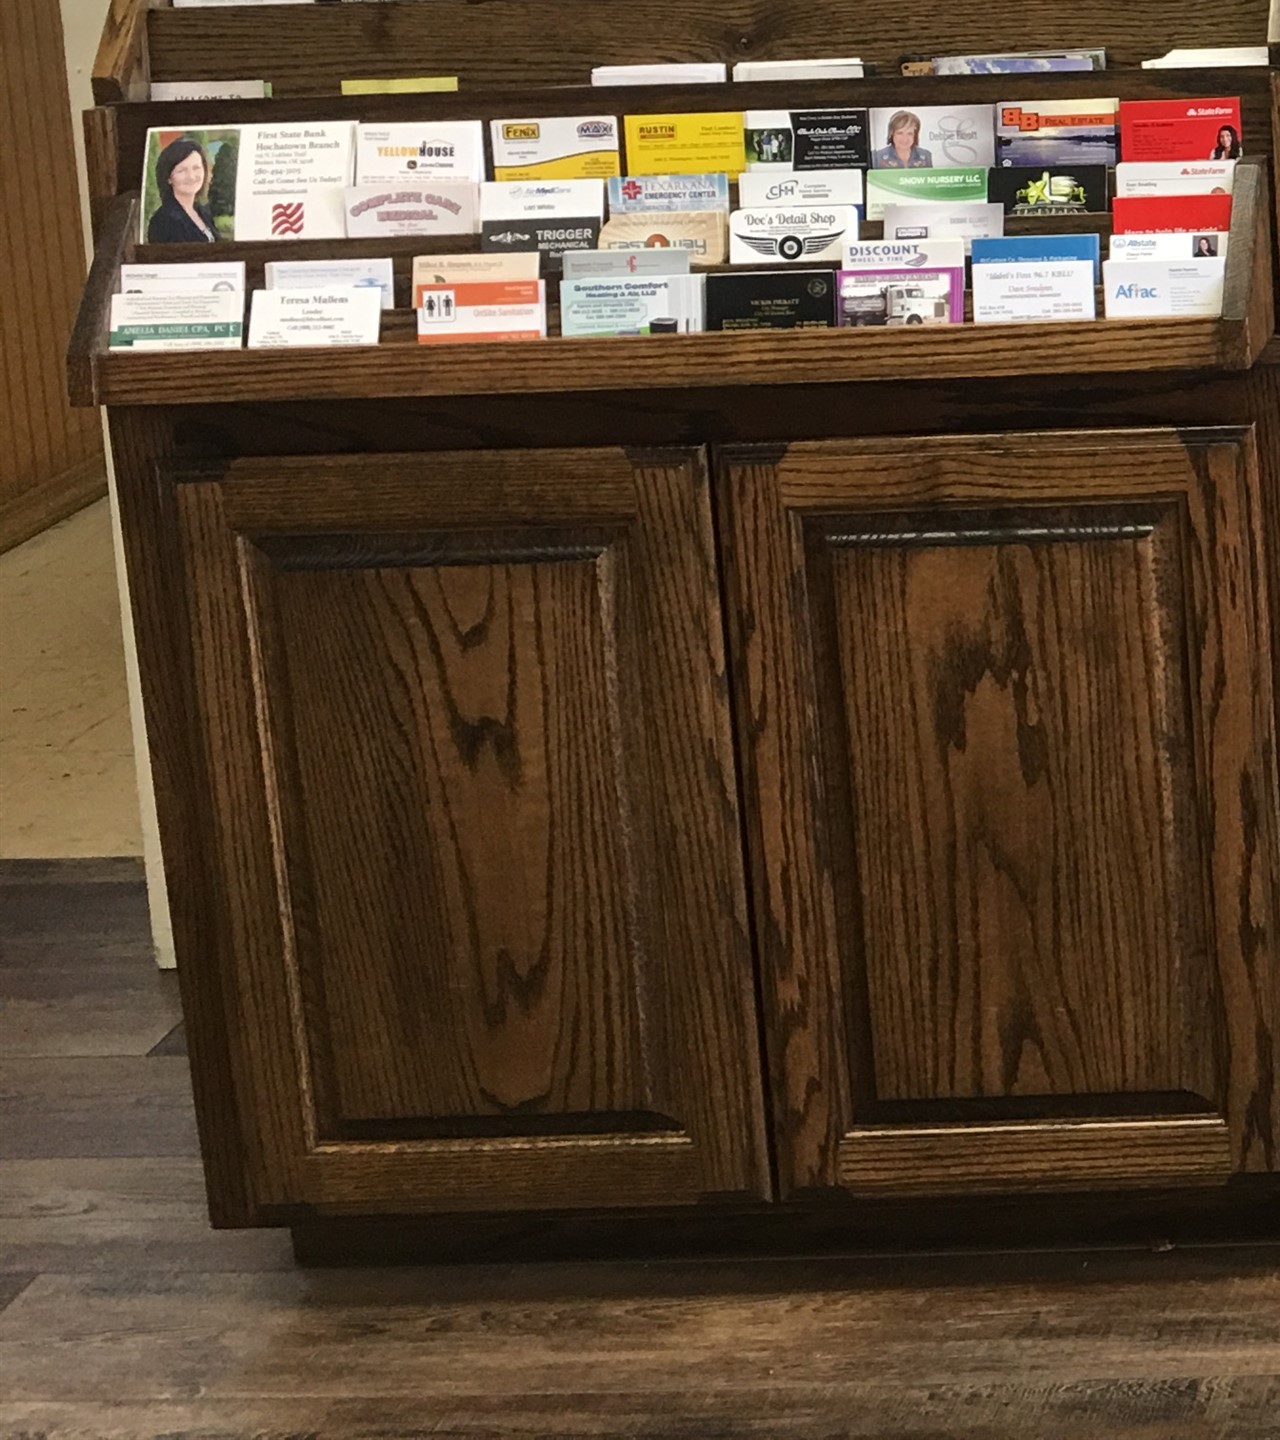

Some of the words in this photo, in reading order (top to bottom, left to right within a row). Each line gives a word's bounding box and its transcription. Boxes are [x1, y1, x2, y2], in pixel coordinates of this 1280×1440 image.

[639, 126, 675, 134] RUSTIN
[688, 190, 716, 198] CENTER
[744, 213, 774, 226] Doc's
[778, 213, 807, 225] Detail
[810, 213, 836, 227] Shop
[536, 229, 593, 240] TRIGGER
[538, 242, 589, 250] MECHANICAL
[850, 245, 919, 256] DISCOUNT
[574, 284, 622, 292] Southern
[625, 282, 668, 290] Comfort
[1115, 283, 1157, 299] Aflac
